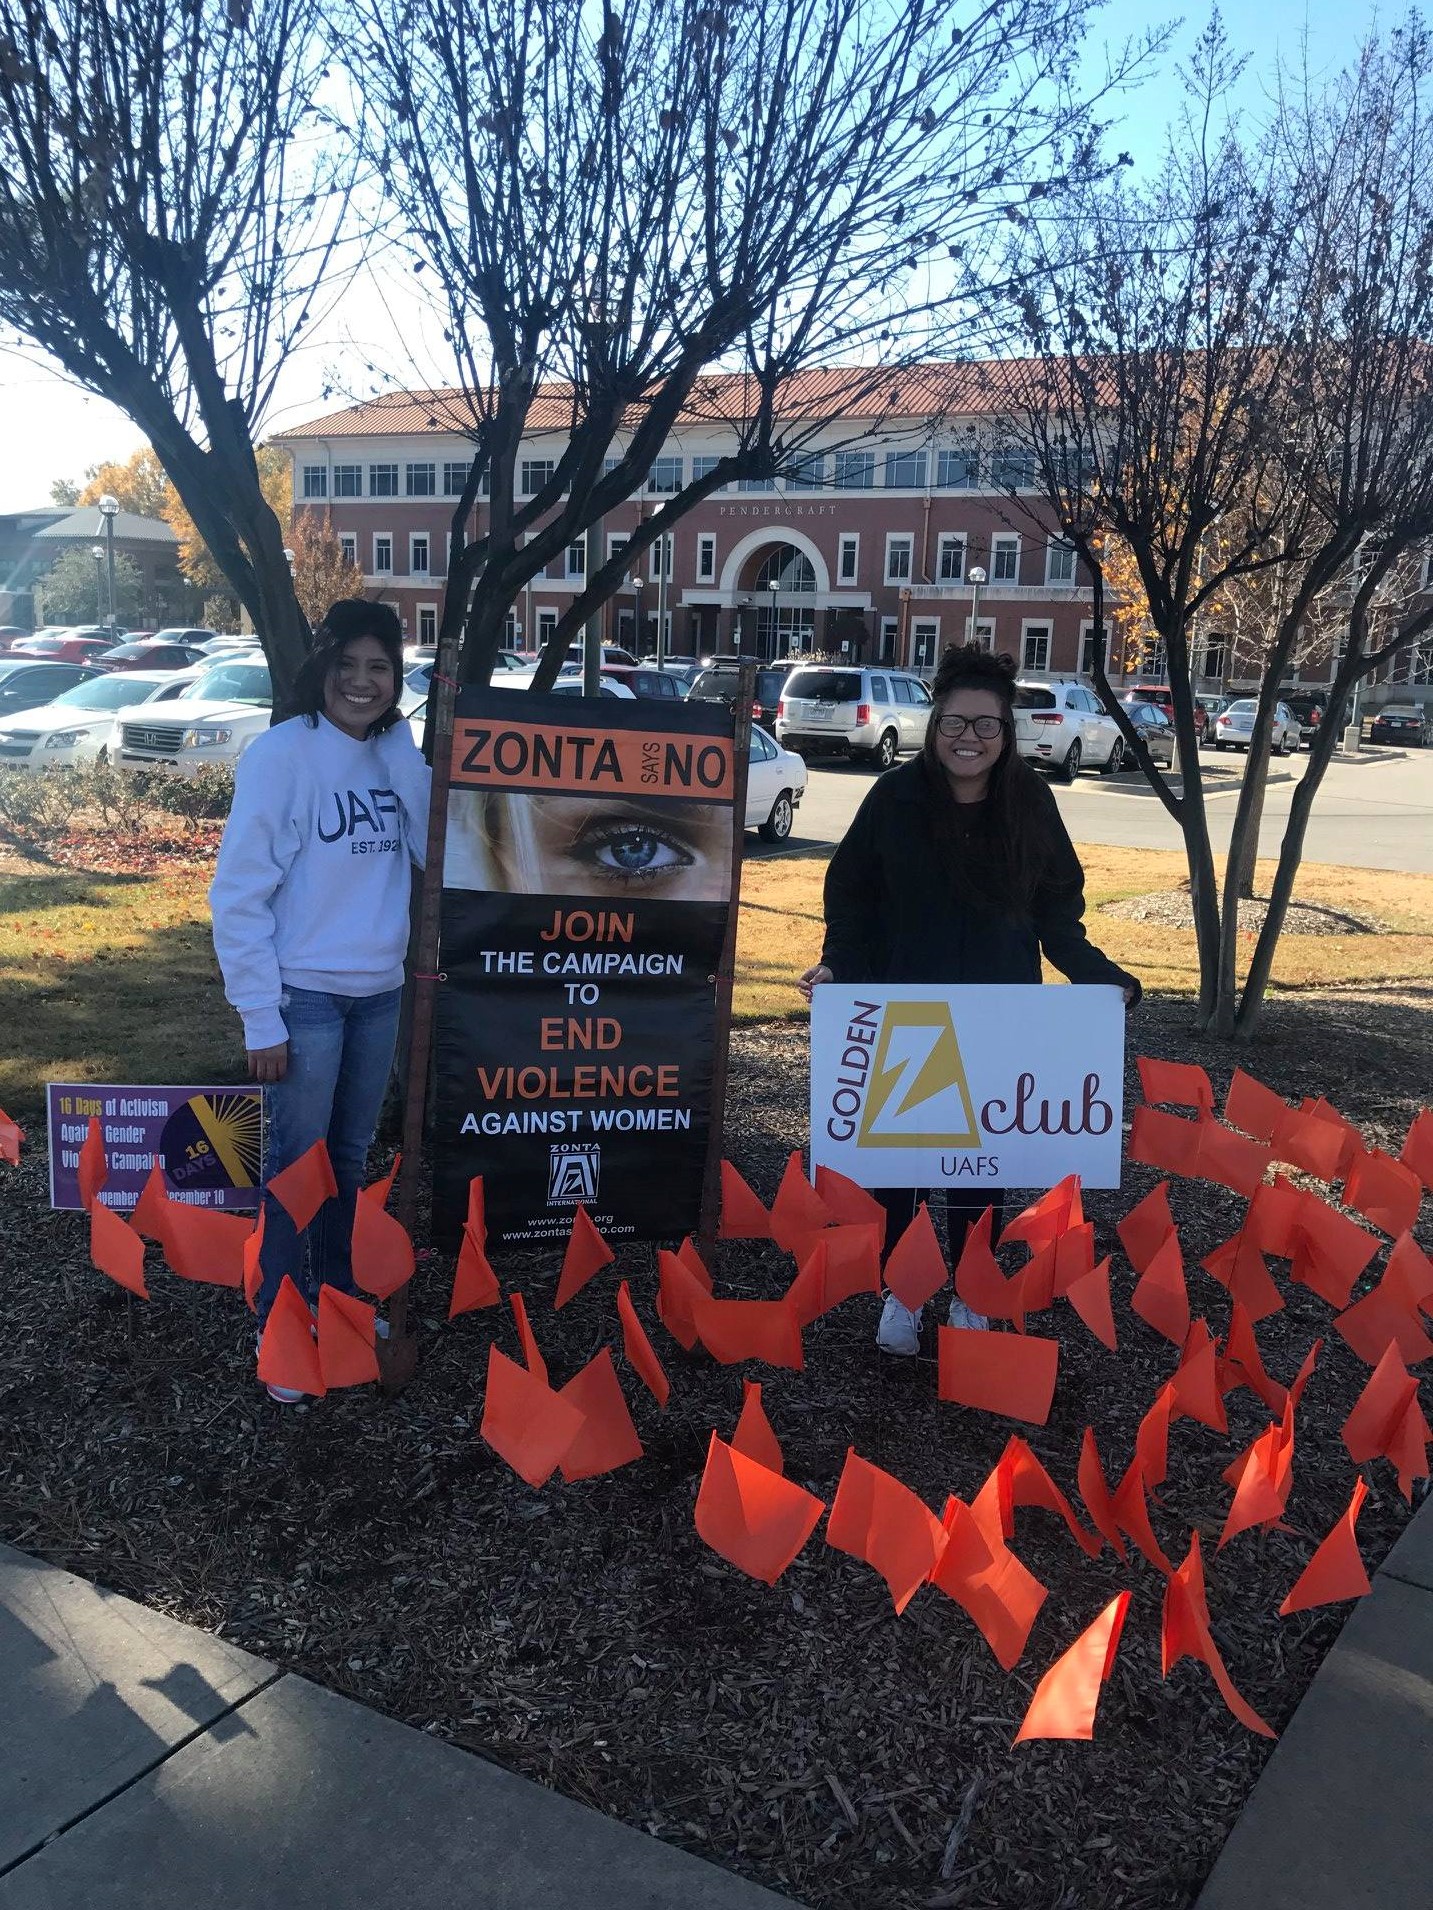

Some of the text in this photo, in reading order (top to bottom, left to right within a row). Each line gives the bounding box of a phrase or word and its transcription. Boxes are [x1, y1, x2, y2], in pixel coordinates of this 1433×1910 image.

[461, 729, 726, 789] ZONTA SAYS NO
[317, 789, 409, 843] UAF
[540, 910, 635, 943] JOIN
[480, 951, 684, 975] THE CAMPAIGN
[564, 983, 600, 1005] TO
[540, 1017, 623, 1051] END
[477, 1065, 680, 1100] VIOLENCE
[826, 1000, 882, 1141] GOLDEN
[59, 1097, 169, 1117] 16 Days of Activism
[980, 1072, 1113, 1136] club
[460, 1108, 691, 1135] AGAINST WOMEN
[105, 1125, 146, 1144] Gender
[185, 1140, 209, 1160] 16
[550, 1143, 601, 1152] ZONTA
[111, 1152, 166, 1172] Campain
[172, 1153, 216, 1181] DAYS
[941, 1156, 999, 1176] UAFS
[167, 1189, 225, 1205] ecember 10
